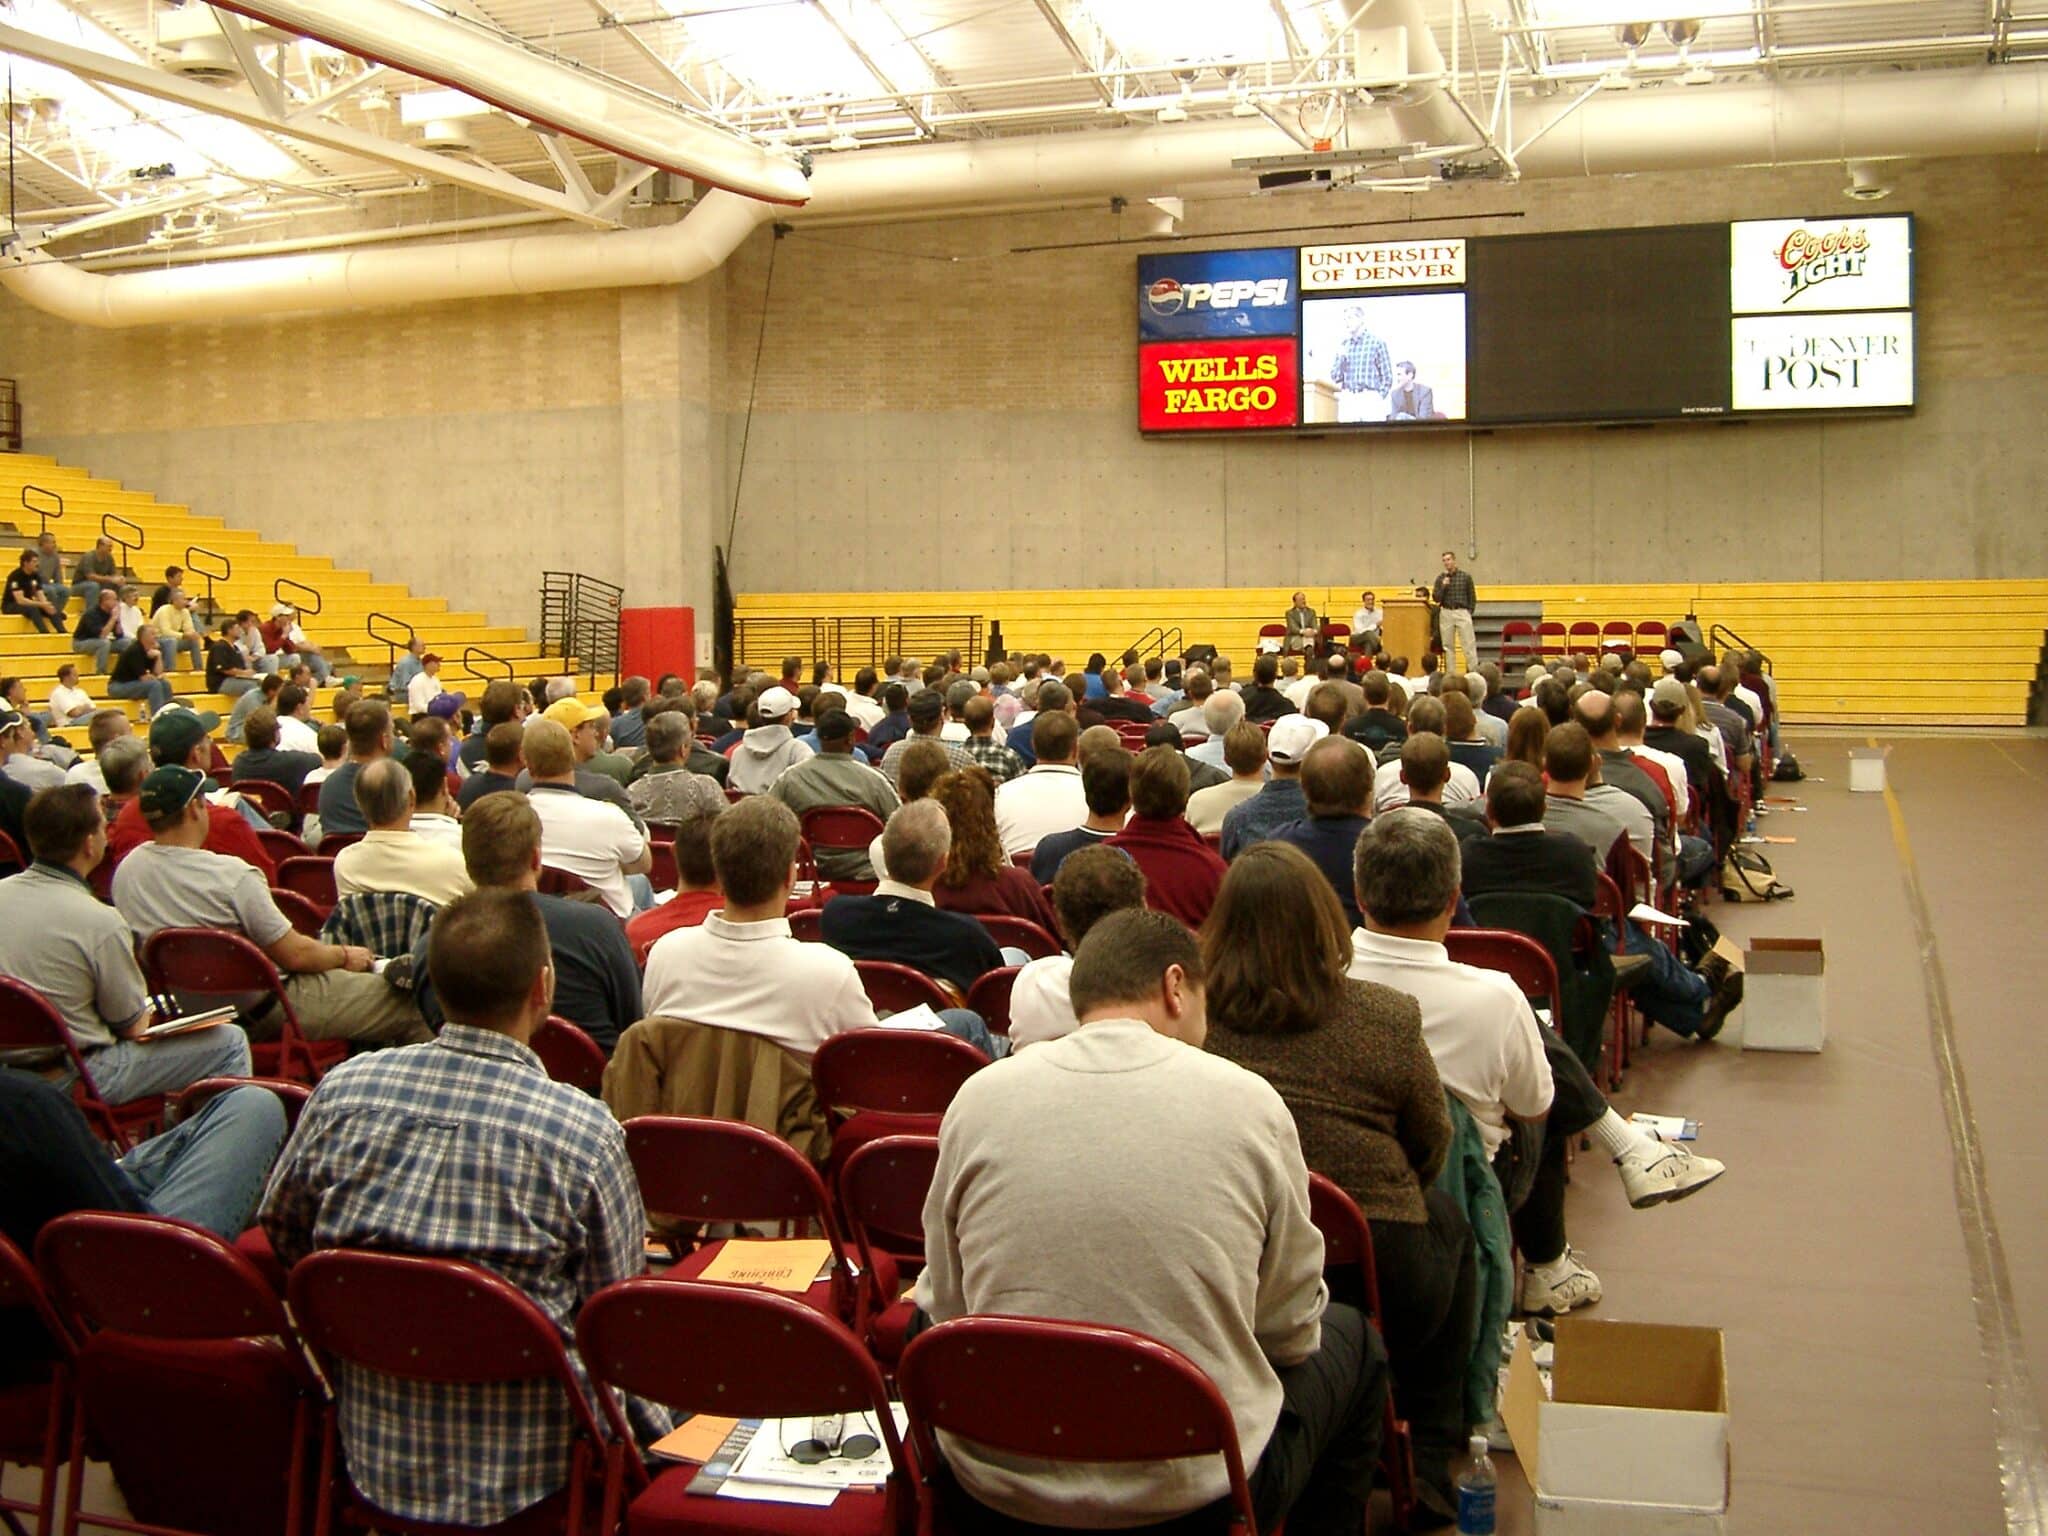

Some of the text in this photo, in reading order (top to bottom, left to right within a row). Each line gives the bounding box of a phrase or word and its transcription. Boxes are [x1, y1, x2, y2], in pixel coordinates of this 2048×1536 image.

[1306, 246, 1461, 267] UNIVERSITY
[1776, 226, 1871, 272] Coors
[1312, 264, 1457, 283] OF DENVER
[1186, 278, 1289, 310] PEPSI
[1788, 335, 1899, 357] DENVER
[1158, 355, 1278, 383] WELLS
[1762, 356, 1868, 391] POST
[1164, 386, 1277, 414] FARGO
